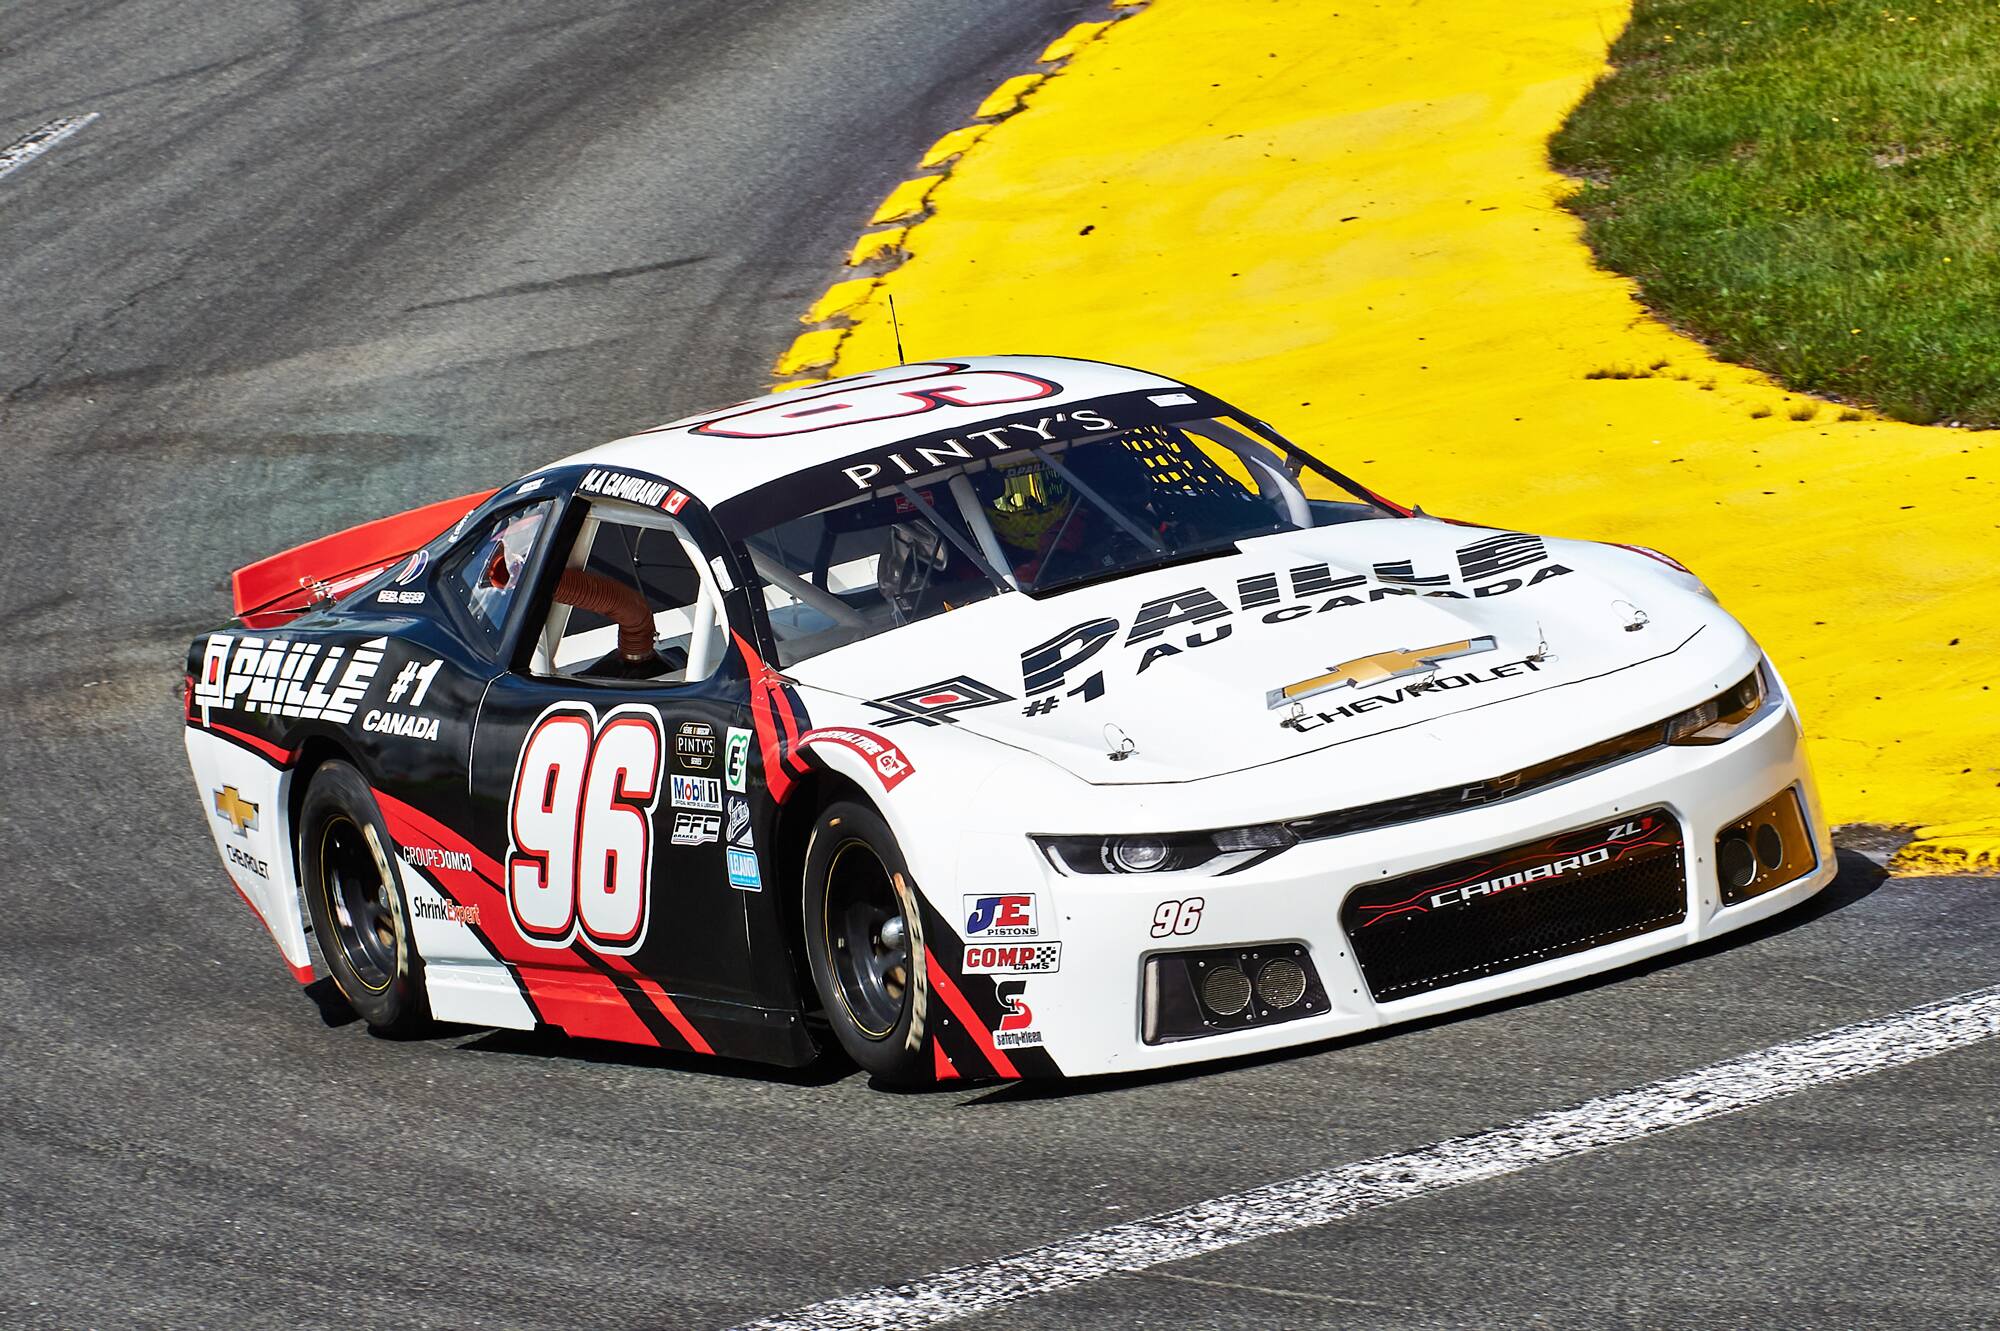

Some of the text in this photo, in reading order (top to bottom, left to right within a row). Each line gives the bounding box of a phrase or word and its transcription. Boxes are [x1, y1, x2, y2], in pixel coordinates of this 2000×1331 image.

[842, 410, 1119, 489] PINTY'S
[601, 473, 670, 507] CAMIRAND
[1022, 563, 1575, 718] #1 AU CANADA
[387, 658, 445, 707] #1
[1294, 660, 1546, 733] CHEVROLET
[362, 710, 441, 742] CANADA
[678, 737, 714, 754] PINTY'S
[673, 777, 719, 803] Mobil 1
[505, 700, 666, 957] 96
[675, 812, 720, 836] PFC
[225, 843, 271, 881] CHEVROLET
[1430, 847, 1610, 910] CAMARO
[413, 896, 482, 928] ShrinkExpert
[966, 895, 1031, 935] JE
[1149, 896, 1205, 939] 96
[986, 927, 1037, 936] PISTONS
[966, 946, 1036, 968] COMP
[1013, 961, 1050, 971] CAMS
[996, 1030, 1042, 1047] safety-kleen
